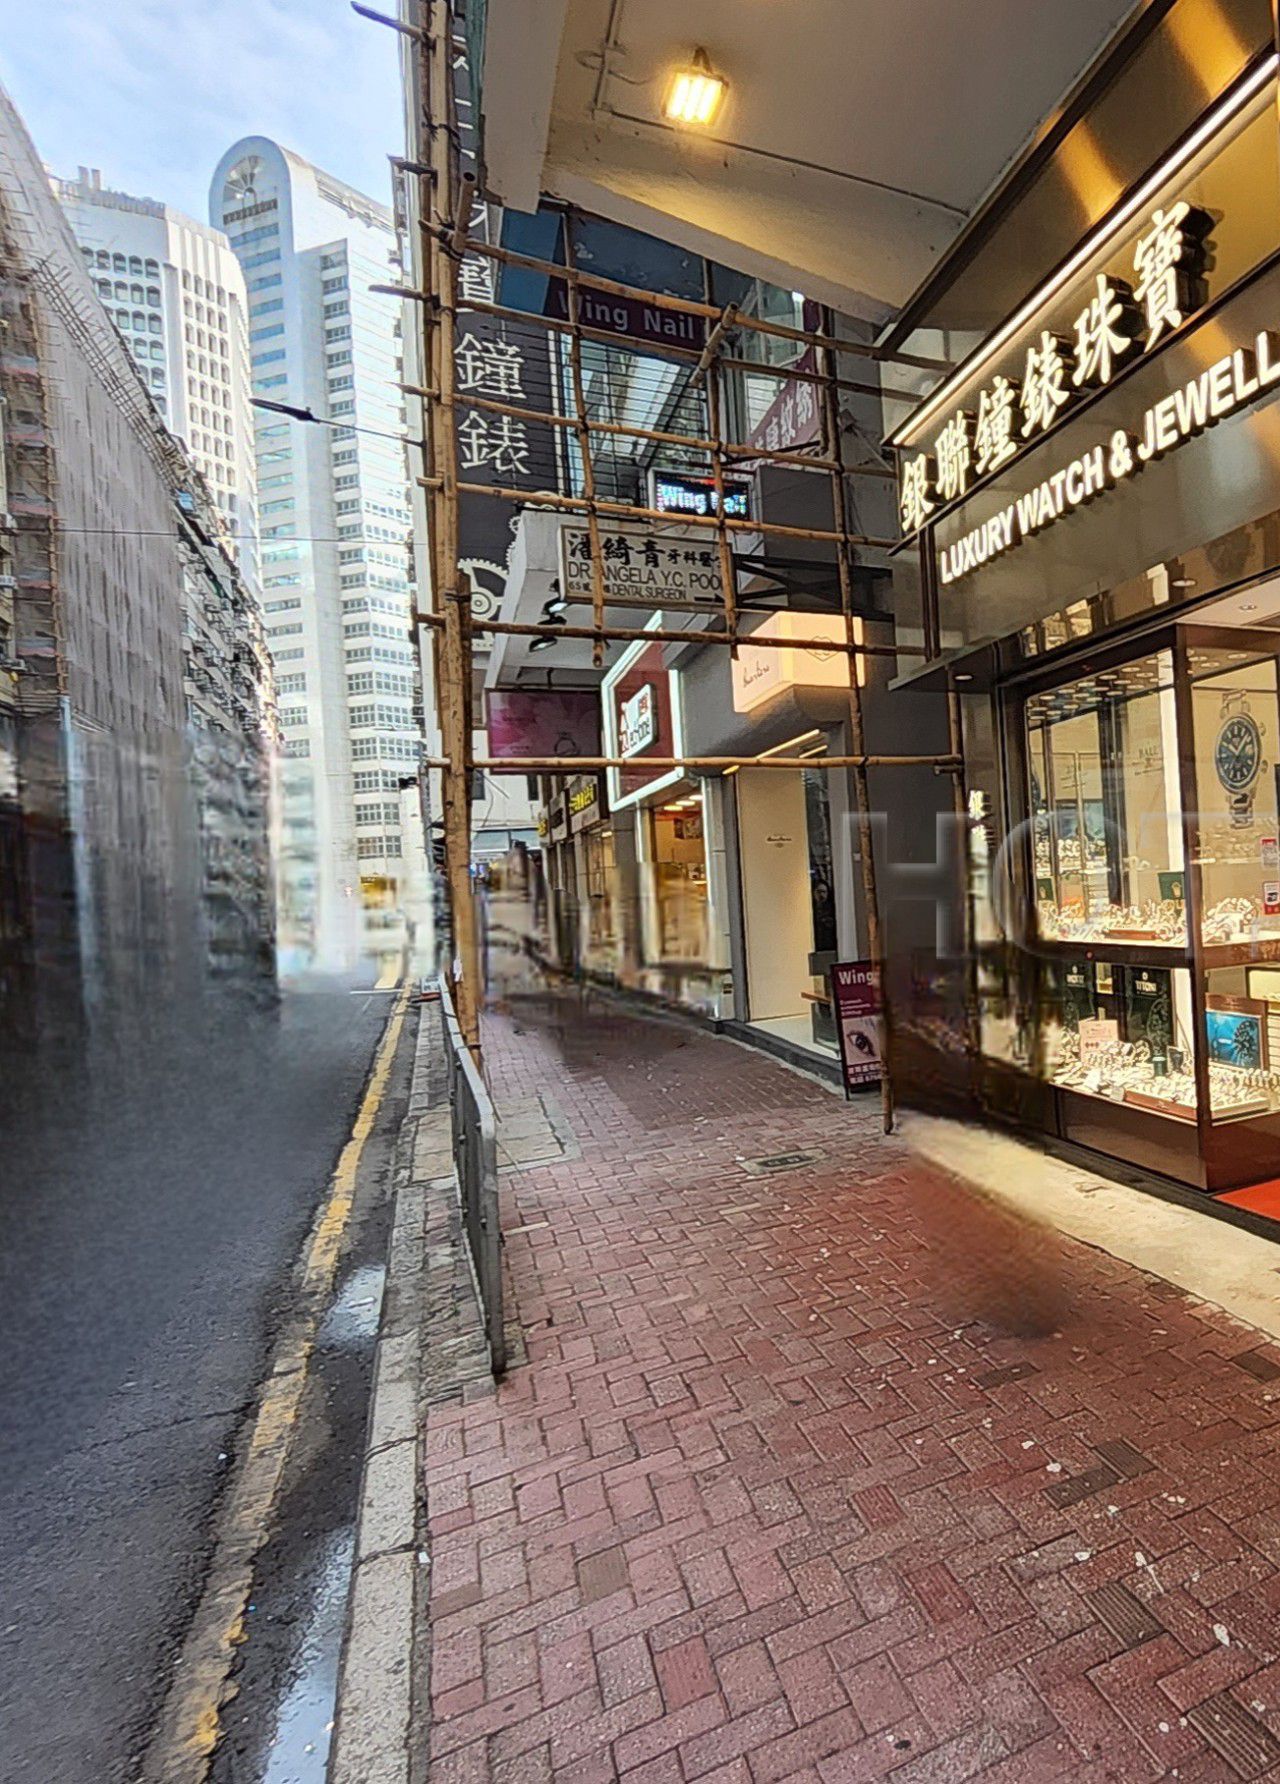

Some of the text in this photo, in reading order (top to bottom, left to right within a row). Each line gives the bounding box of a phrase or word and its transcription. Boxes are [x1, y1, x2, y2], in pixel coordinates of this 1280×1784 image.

[644, 308, 694, 340] Nail
[899, 201, 1190, 531] 銀聯鐘錶珠寶
[940, 504, 1015, 585] LUXURY
[1016, 445, 1105, 536] WATCH
[1109, 428, 1133, 479] &
[667, 549, 722, 570] 牙科醫
[645, 587, 687, 601] SURGEON
[660, 570, 686, 588] Y.C.
[689, 573, 723, 592] POO
